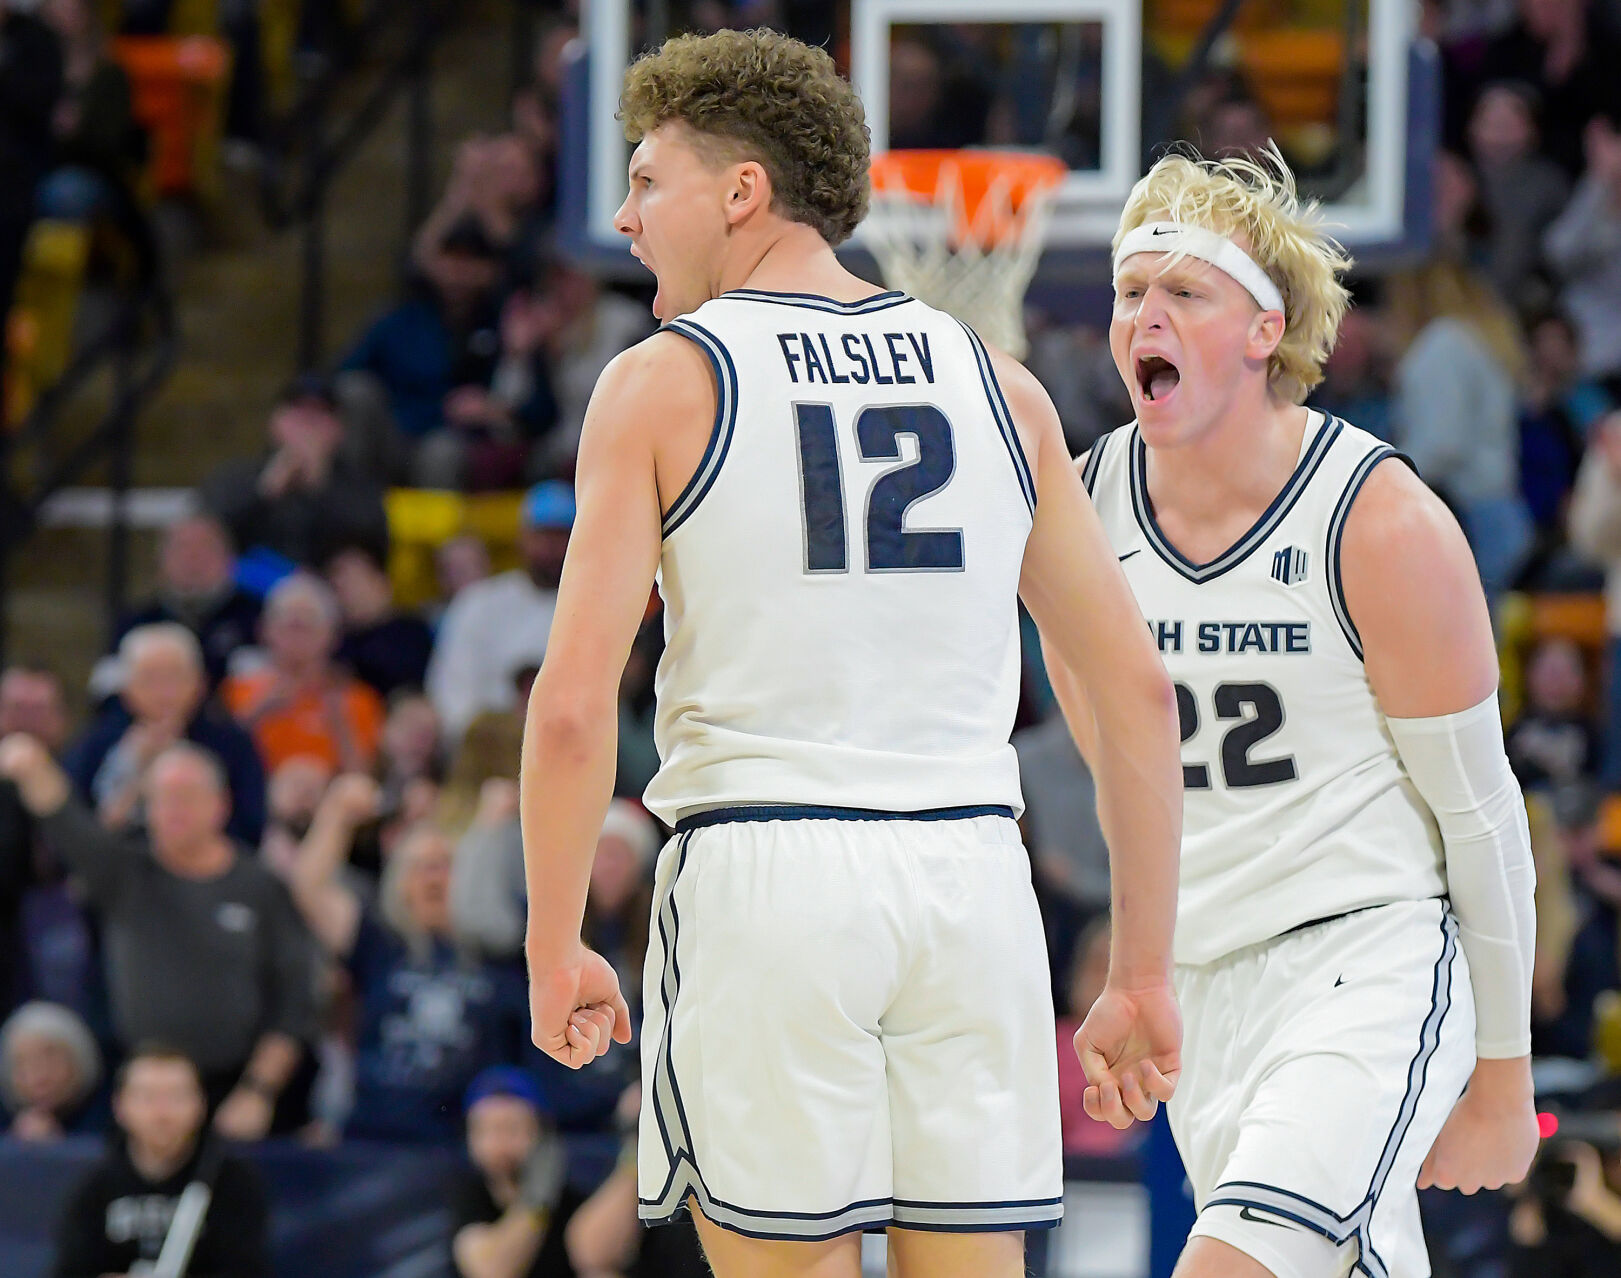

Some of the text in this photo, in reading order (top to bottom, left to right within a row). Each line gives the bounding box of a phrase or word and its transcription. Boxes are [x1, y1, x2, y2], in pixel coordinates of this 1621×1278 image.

[777, 332, 935, 384] FALSLEV
[791, 400, 966, 574] 12
[1148, 619, 1312, 655] H STATE
